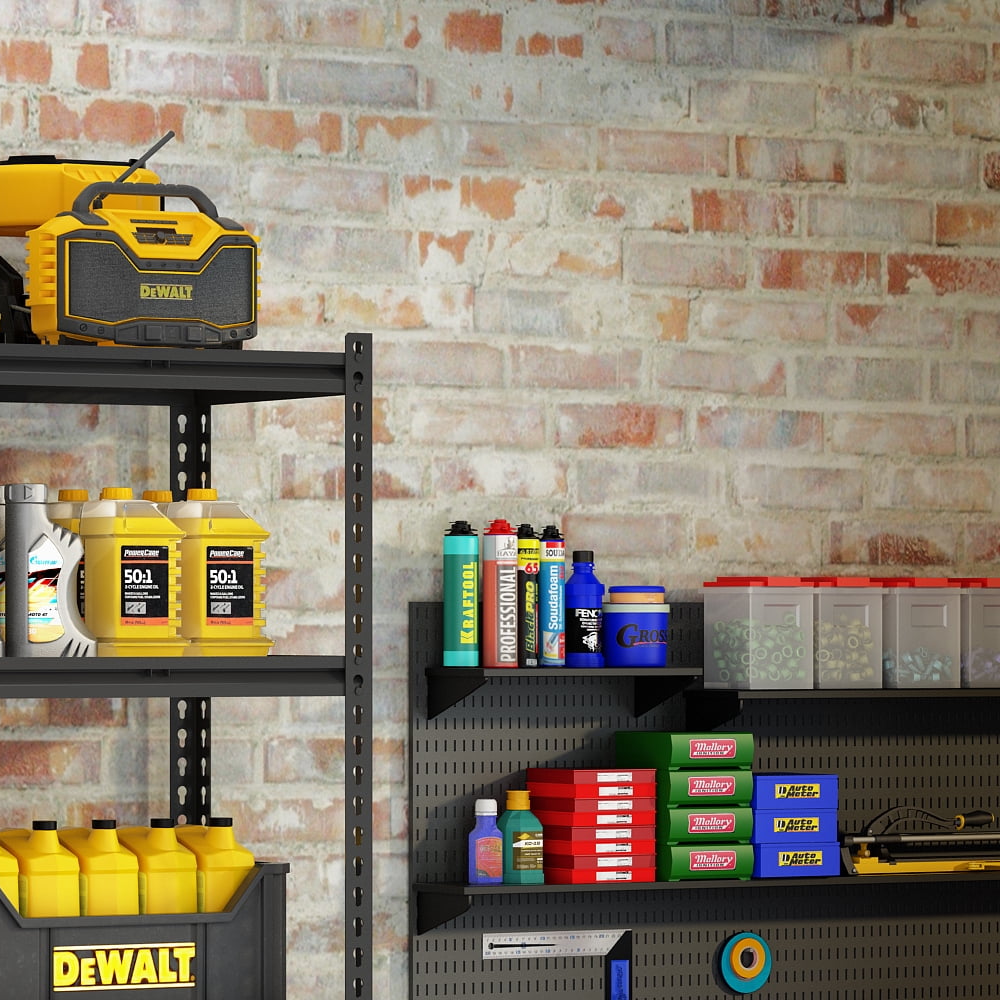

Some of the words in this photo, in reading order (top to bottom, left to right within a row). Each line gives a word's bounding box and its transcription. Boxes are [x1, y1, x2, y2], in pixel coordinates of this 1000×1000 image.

[525, 562, 539, 574] 65
[124, 568, 153, 584] 50:1
[210, 569, 238, 584] 50:1
[460, 561, 475, 644] KRAFTOOL
[549, 565, 558, 630] Soudafoam
[500, 566, 516, 662] PROFESSIONAL
[694, 742, 734, 752] Mallory
[693, 779, 733, 789] Mallory
[693, 817, 733, 827] Mallory
[694, 854, 734, 864] Mallory
[53, 947, 195, 987] DEWALT
